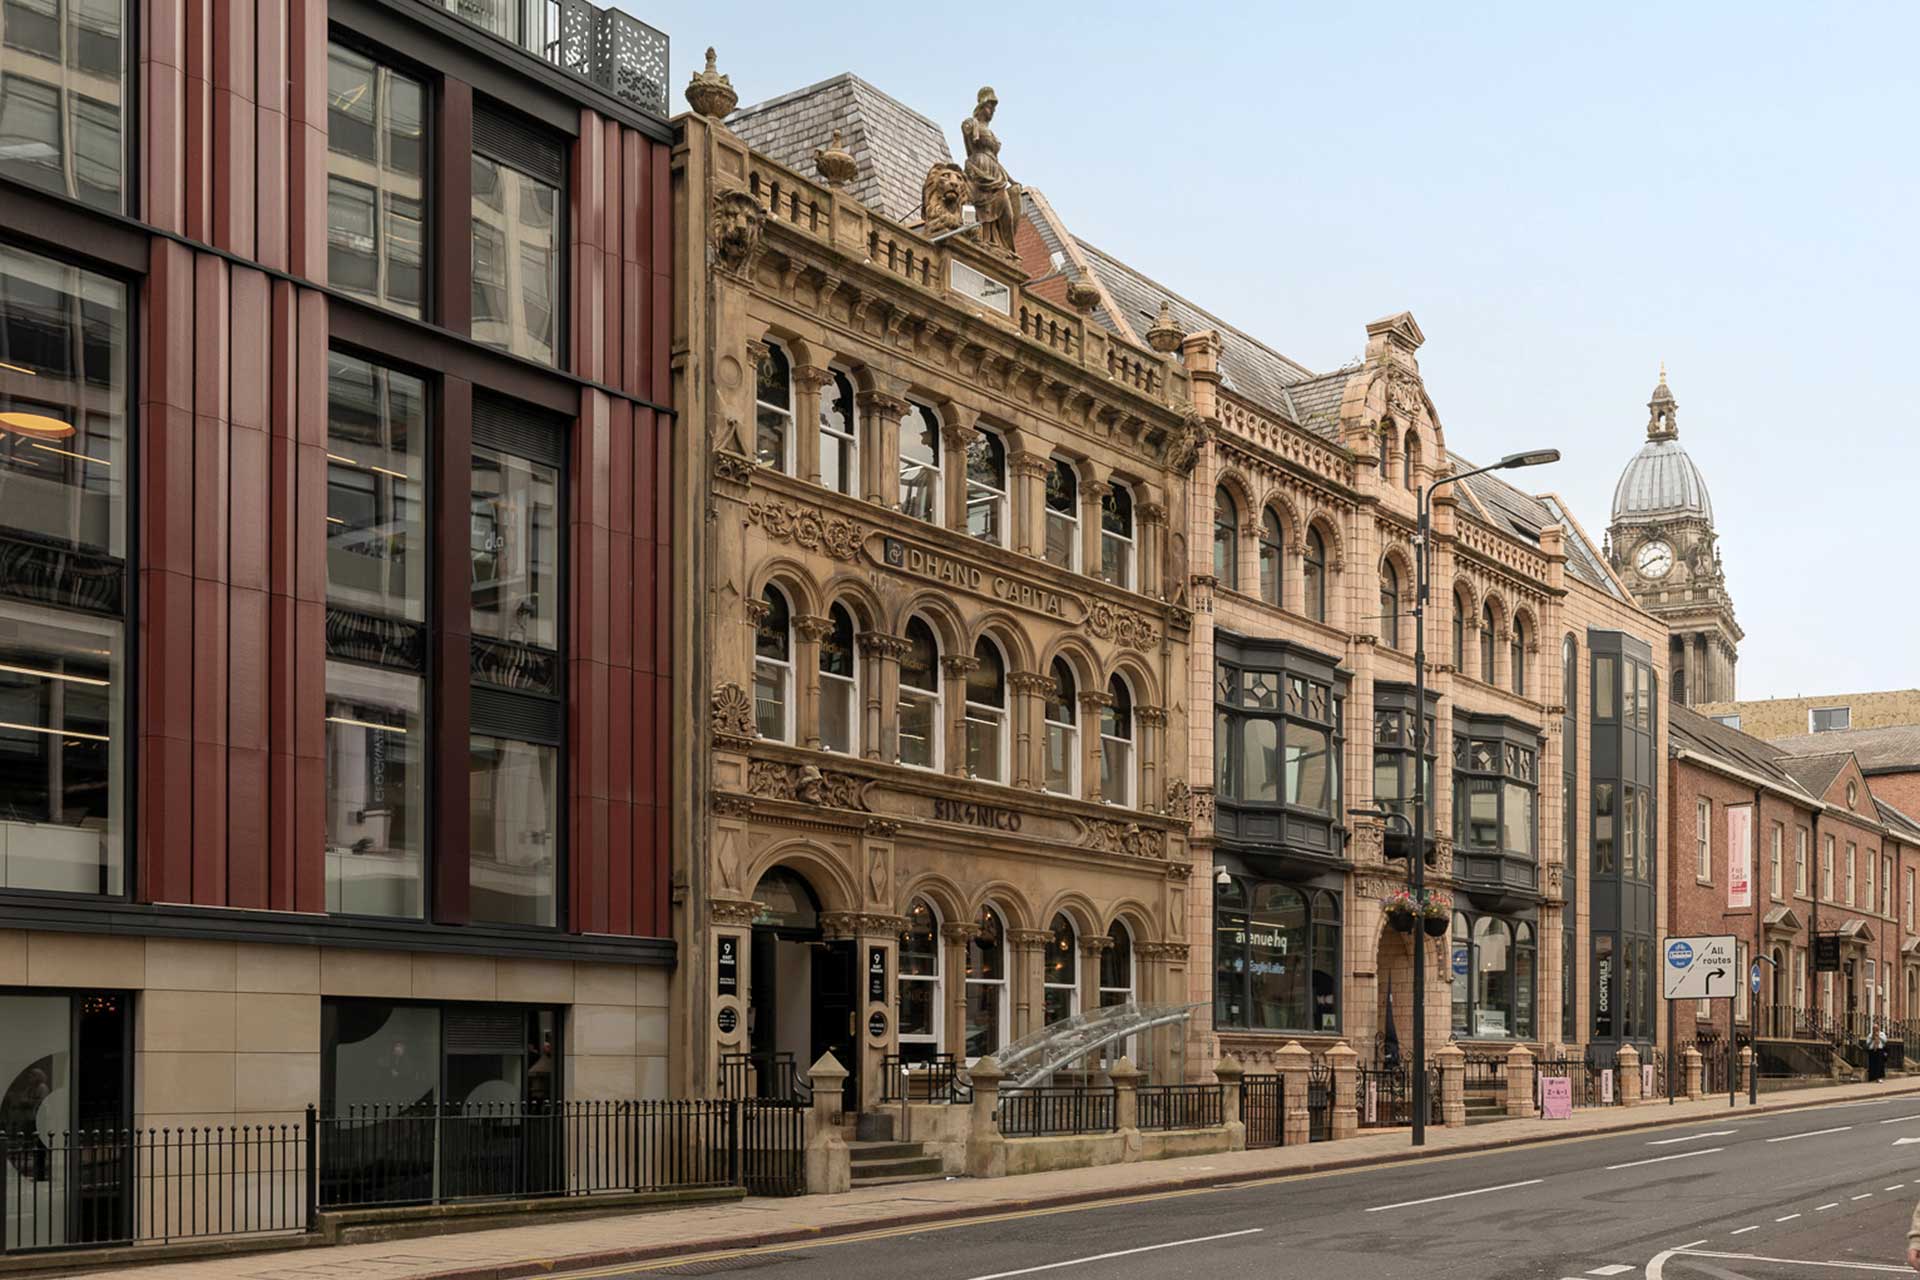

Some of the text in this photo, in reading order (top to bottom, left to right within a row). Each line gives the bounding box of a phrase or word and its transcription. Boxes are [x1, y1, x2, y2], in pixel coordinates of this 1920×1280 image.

[909, 549, 1067, 618] DHAND CAPITAL
[976, 804, 1022, 832] NICO
[723, 943, 732, 954] 9
[1711, 946, 1724, 955] All
[873, 953, 881, 964] 9
[1702, 956, 1732, 965] routes
[1599, 960, 1609, 1012] COCKTAILS
